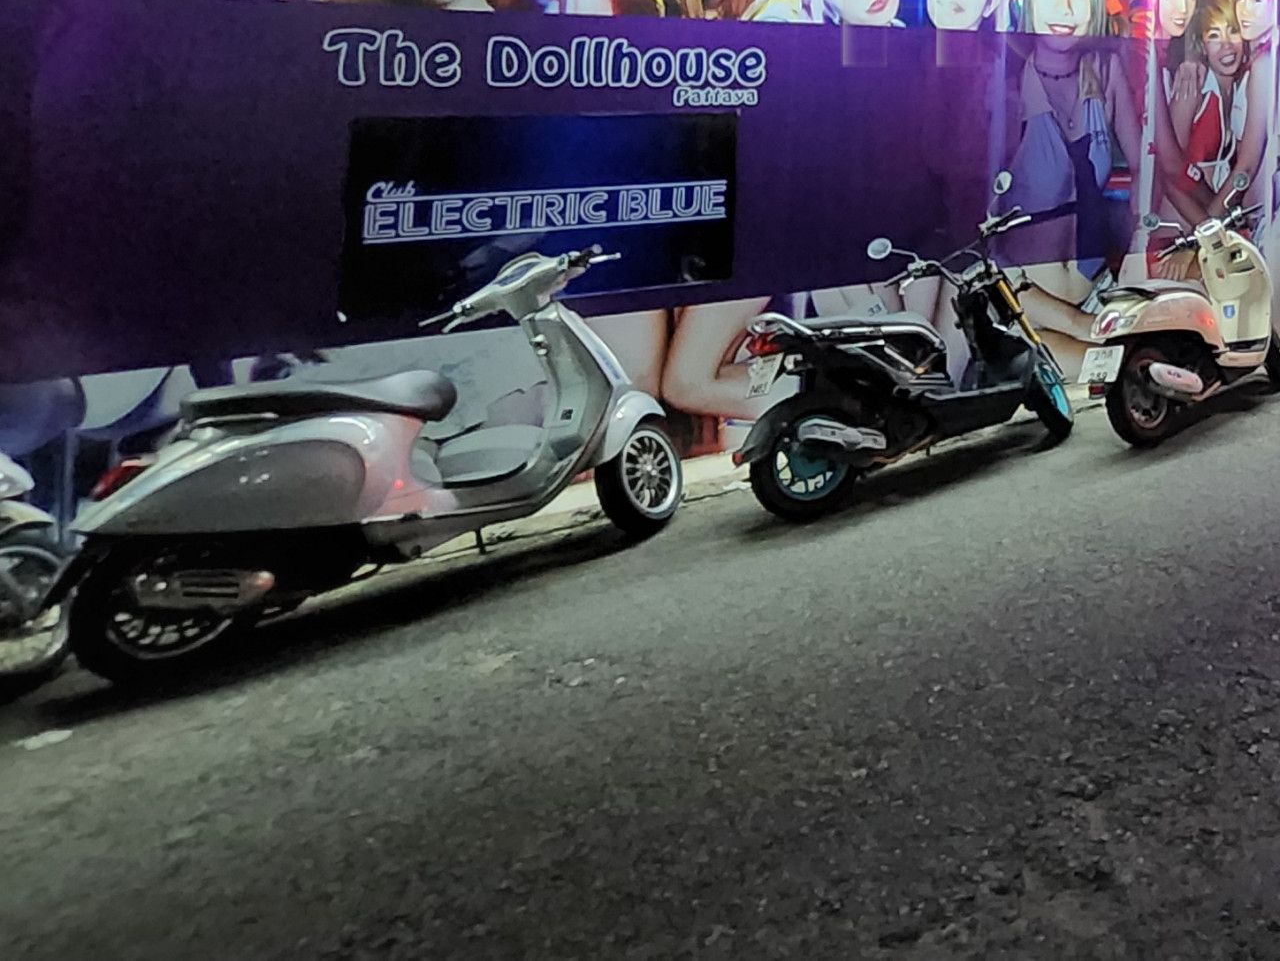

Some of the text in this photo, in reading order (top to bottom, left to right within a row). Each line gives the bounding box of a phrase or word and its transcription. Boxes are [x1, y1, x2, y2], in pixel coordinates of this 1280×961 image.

[323, 28, 767, 88] The Dollhouse
[673, 87, 758, 107] Pattaya
[366, 180, 416, 203] Club
[363, 185, 727, 238] ELECTRIC BLUE
